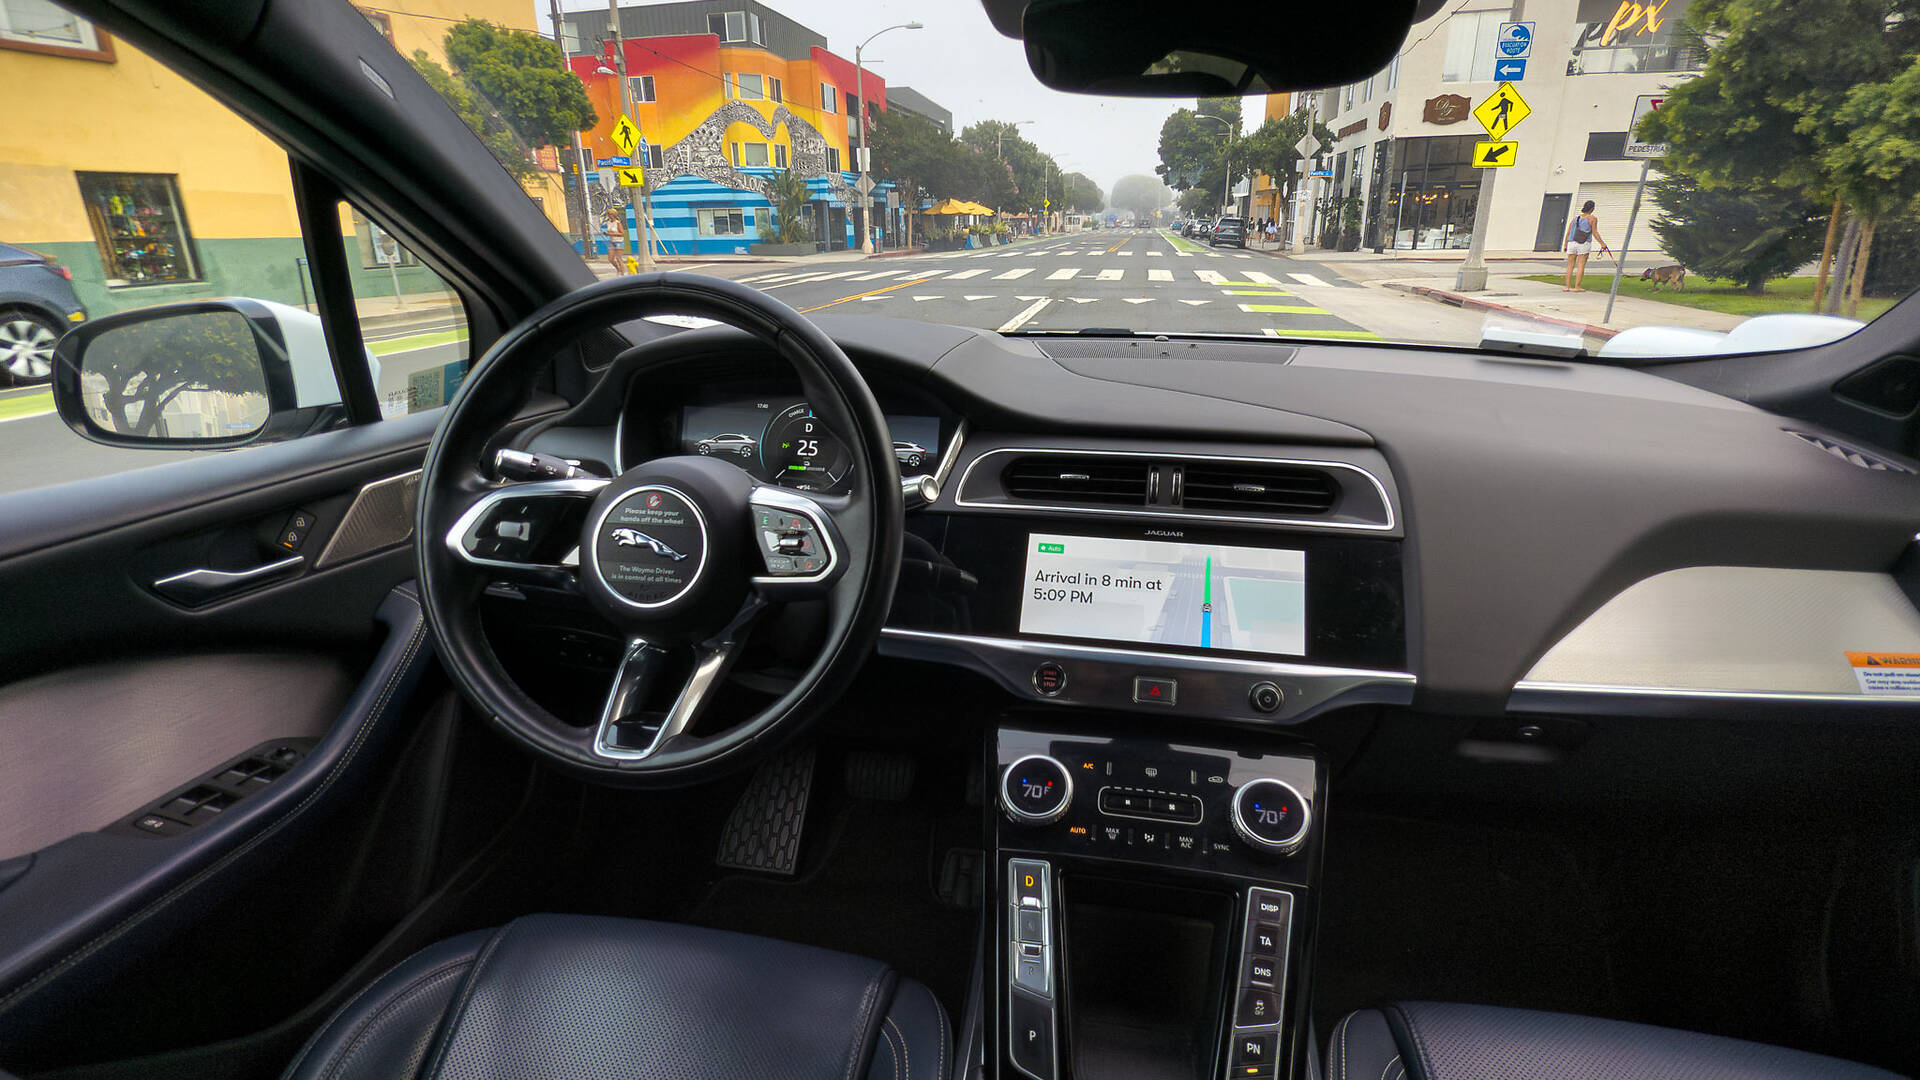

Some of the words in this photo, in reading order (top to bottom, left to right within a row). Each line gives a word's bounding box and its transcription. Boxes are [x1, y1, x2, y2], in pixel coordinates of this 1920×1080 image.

[744, 175, 767, 193] LOVE
[805, 423, 813, 432] D
[797, 439, 818, 456] 25
[647, 508, 663, 516] keep
[664, 517, 683, 525] wheel
[632, 566, 654, 574] Waymo
[1035, 570, 1081, 585] Arrival
[1085, 573, 1097, 586] in
[1102, 575, 1111, 587] 8
[1115, 576, 1142, 589] min
[1146, 579, 1162, 591] at
[1033, 588, 1066, 601] 5:09
[1070, 590, 1093, 604] PM
[1069, 826, 1087, 834] AUTO
[1213, 843, 1230, 851] SYNC
[1025, 875, 1034, 887] D
[1261, 903, 1279, 913] DISP
[1259, 936, 1272, 947] TA
[1254, 967, 1272, 977] DNS
[1029, 1031, 1037, 1041] P
